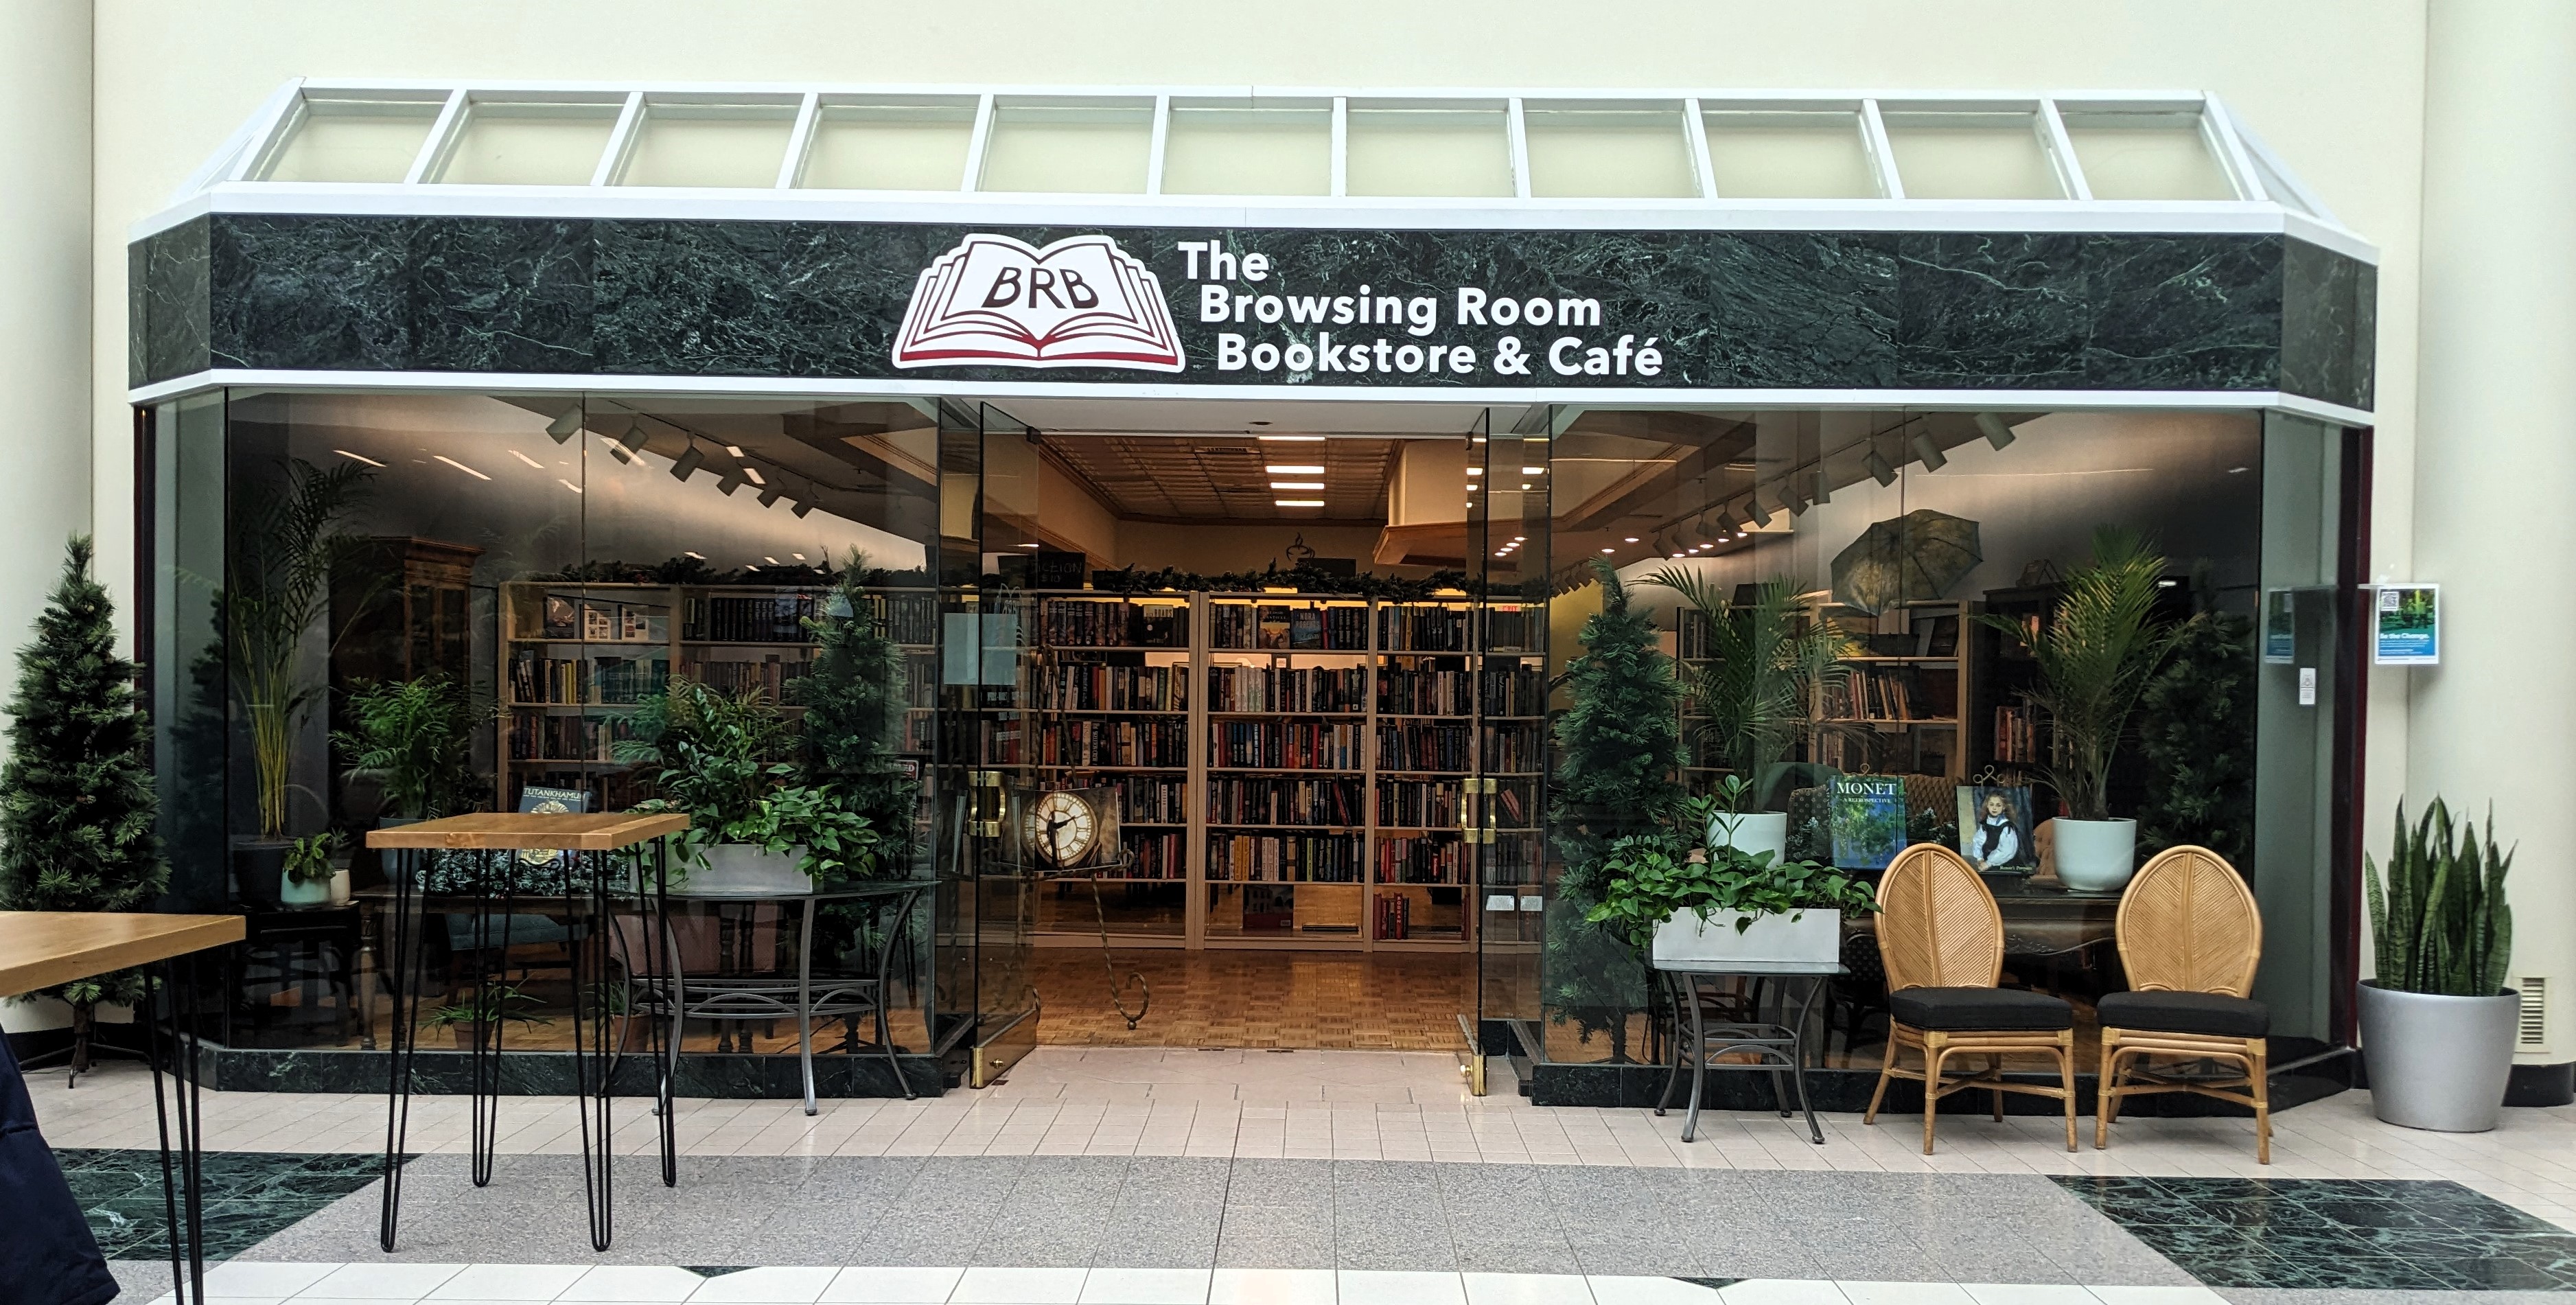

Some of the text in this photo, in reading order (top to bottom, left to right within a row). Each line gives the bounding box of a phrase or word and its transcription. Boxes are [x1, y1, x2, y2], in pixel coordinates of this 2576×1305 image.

[1178, 240, 1269, 281] The
[981, 266, 1099, 309] BRB
[1200, 284, 1601, 336] Browsing Room
[1218, 332, 1662, 376] Bookstore & Café
[1836, 782, 1897, 795] MONET
